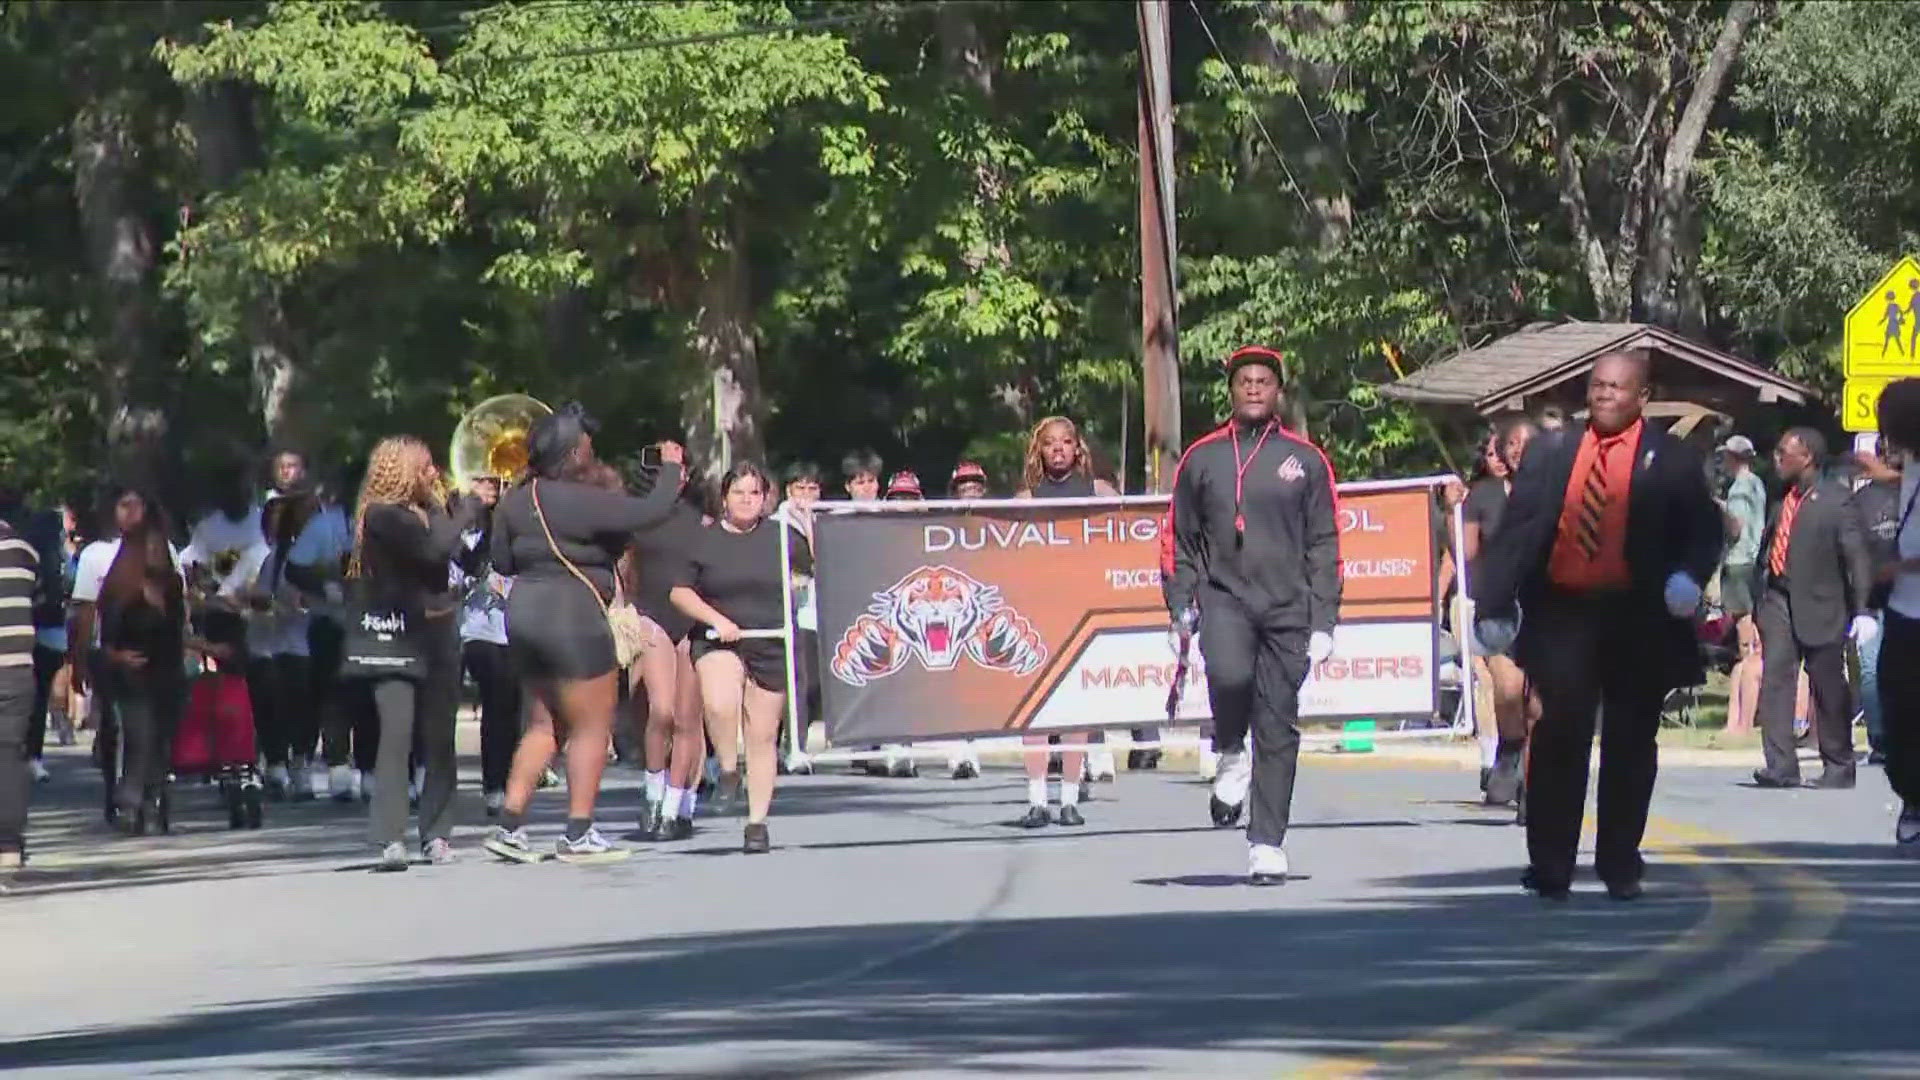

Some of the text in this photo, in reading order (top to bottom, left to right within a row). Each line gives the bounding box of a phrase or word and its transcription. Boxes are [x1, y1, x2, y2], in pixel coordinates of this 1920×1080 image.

[923, 520, 1070, 553] DUVAL
[1083, 517, 1168, 545] HIG
[1104, 558, 1417, 591] "EXCE XCUSES"
[1313, 655, 1424, 682] IGERS
